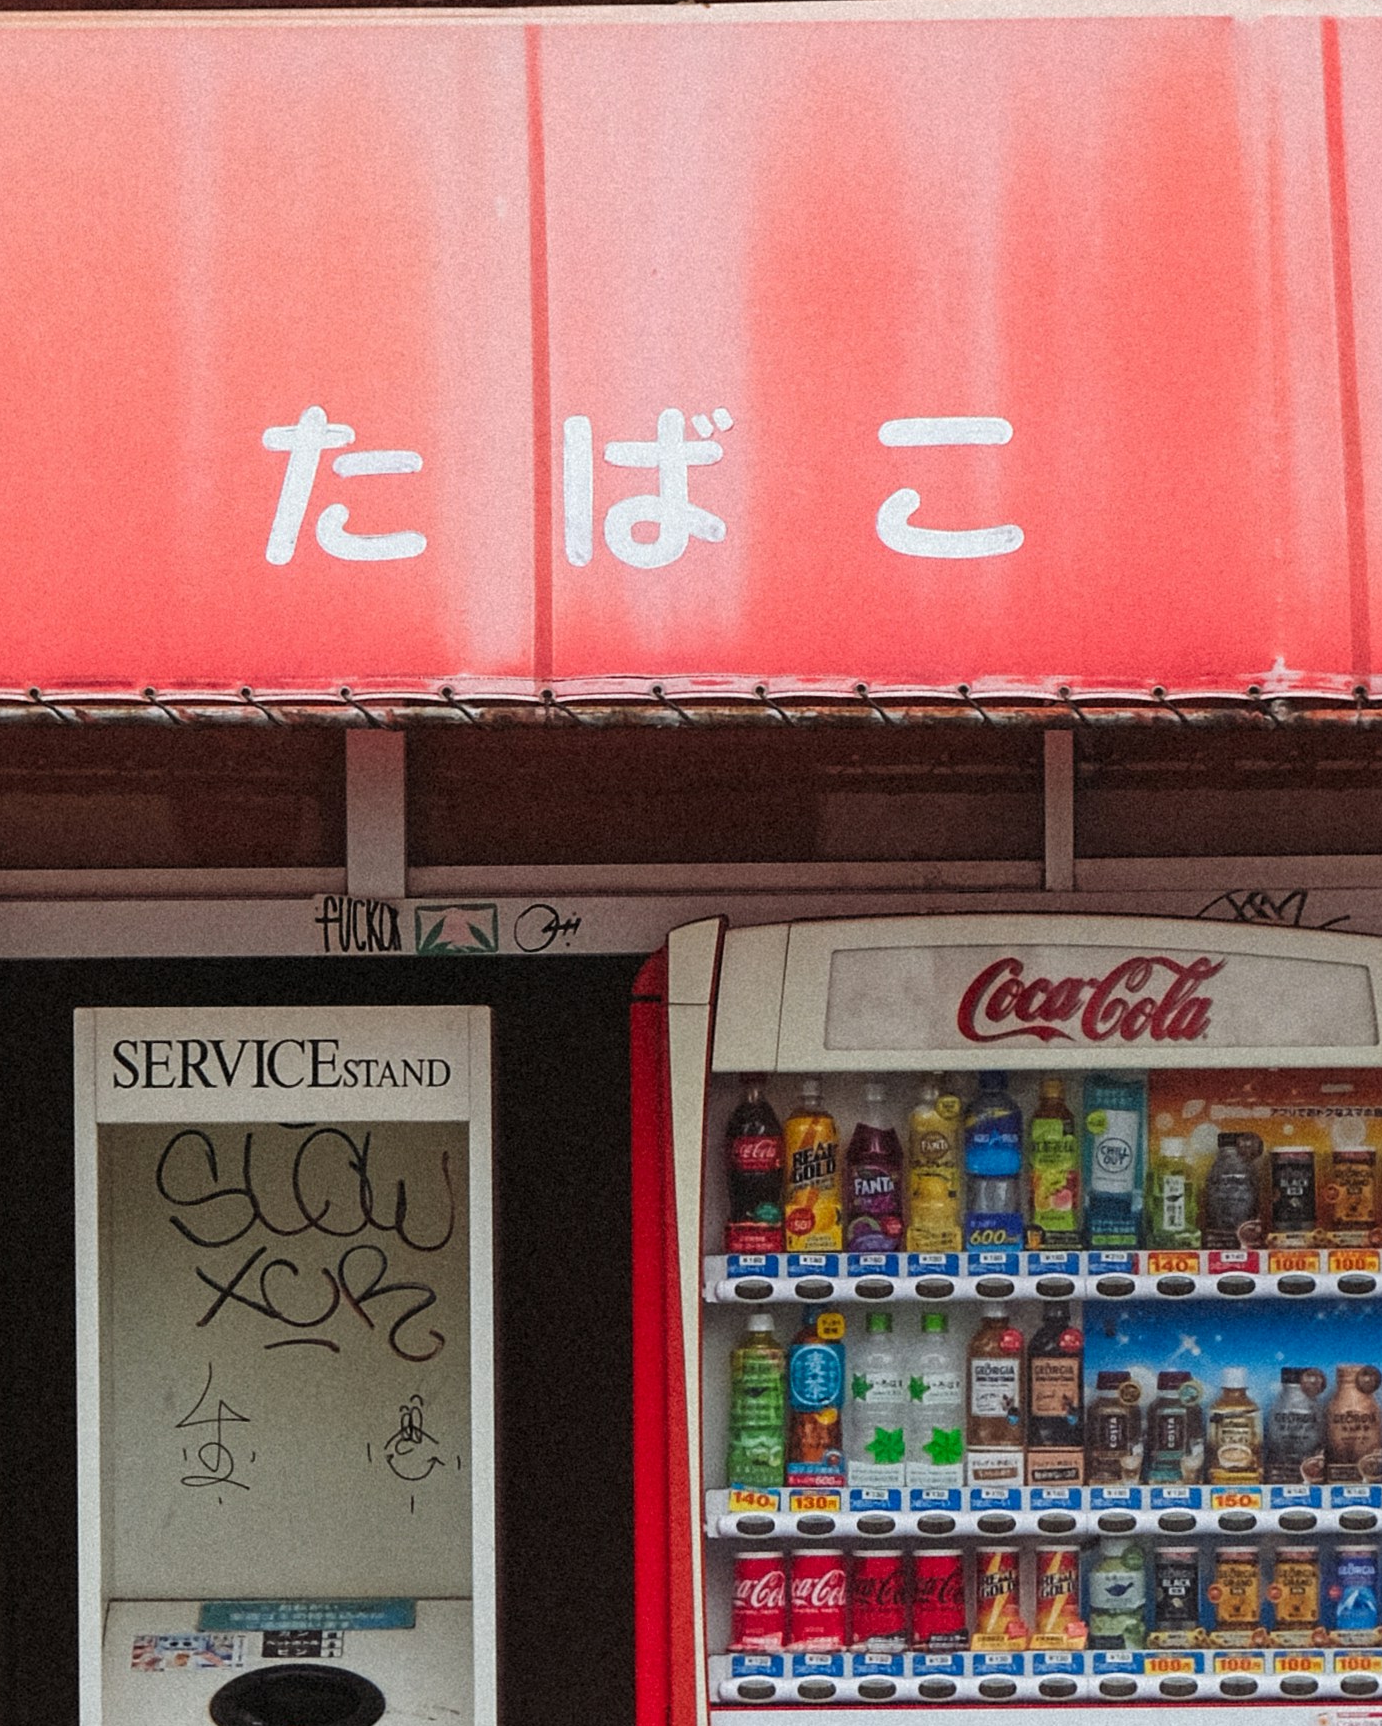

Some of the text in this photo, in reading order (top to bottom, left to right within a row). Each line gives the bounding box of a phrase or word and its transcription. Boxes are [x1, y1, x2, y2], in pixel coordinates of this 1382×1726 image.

[262, 405, 1024, 570] たばこ
[956, 956, 1229, 1043] Coca-Cola
[111, 1038, 452, 1090] SERVICE STAND
[1099, 1145, 1130, 1158] CHILL
[1103, 1154, 1125, 1166] OUT
[854, 1176, 895, 1195] FANTA
[804, 1351, 827, 1399] 麦茶
[1162, 1579, 1191, 1587] BLACK
